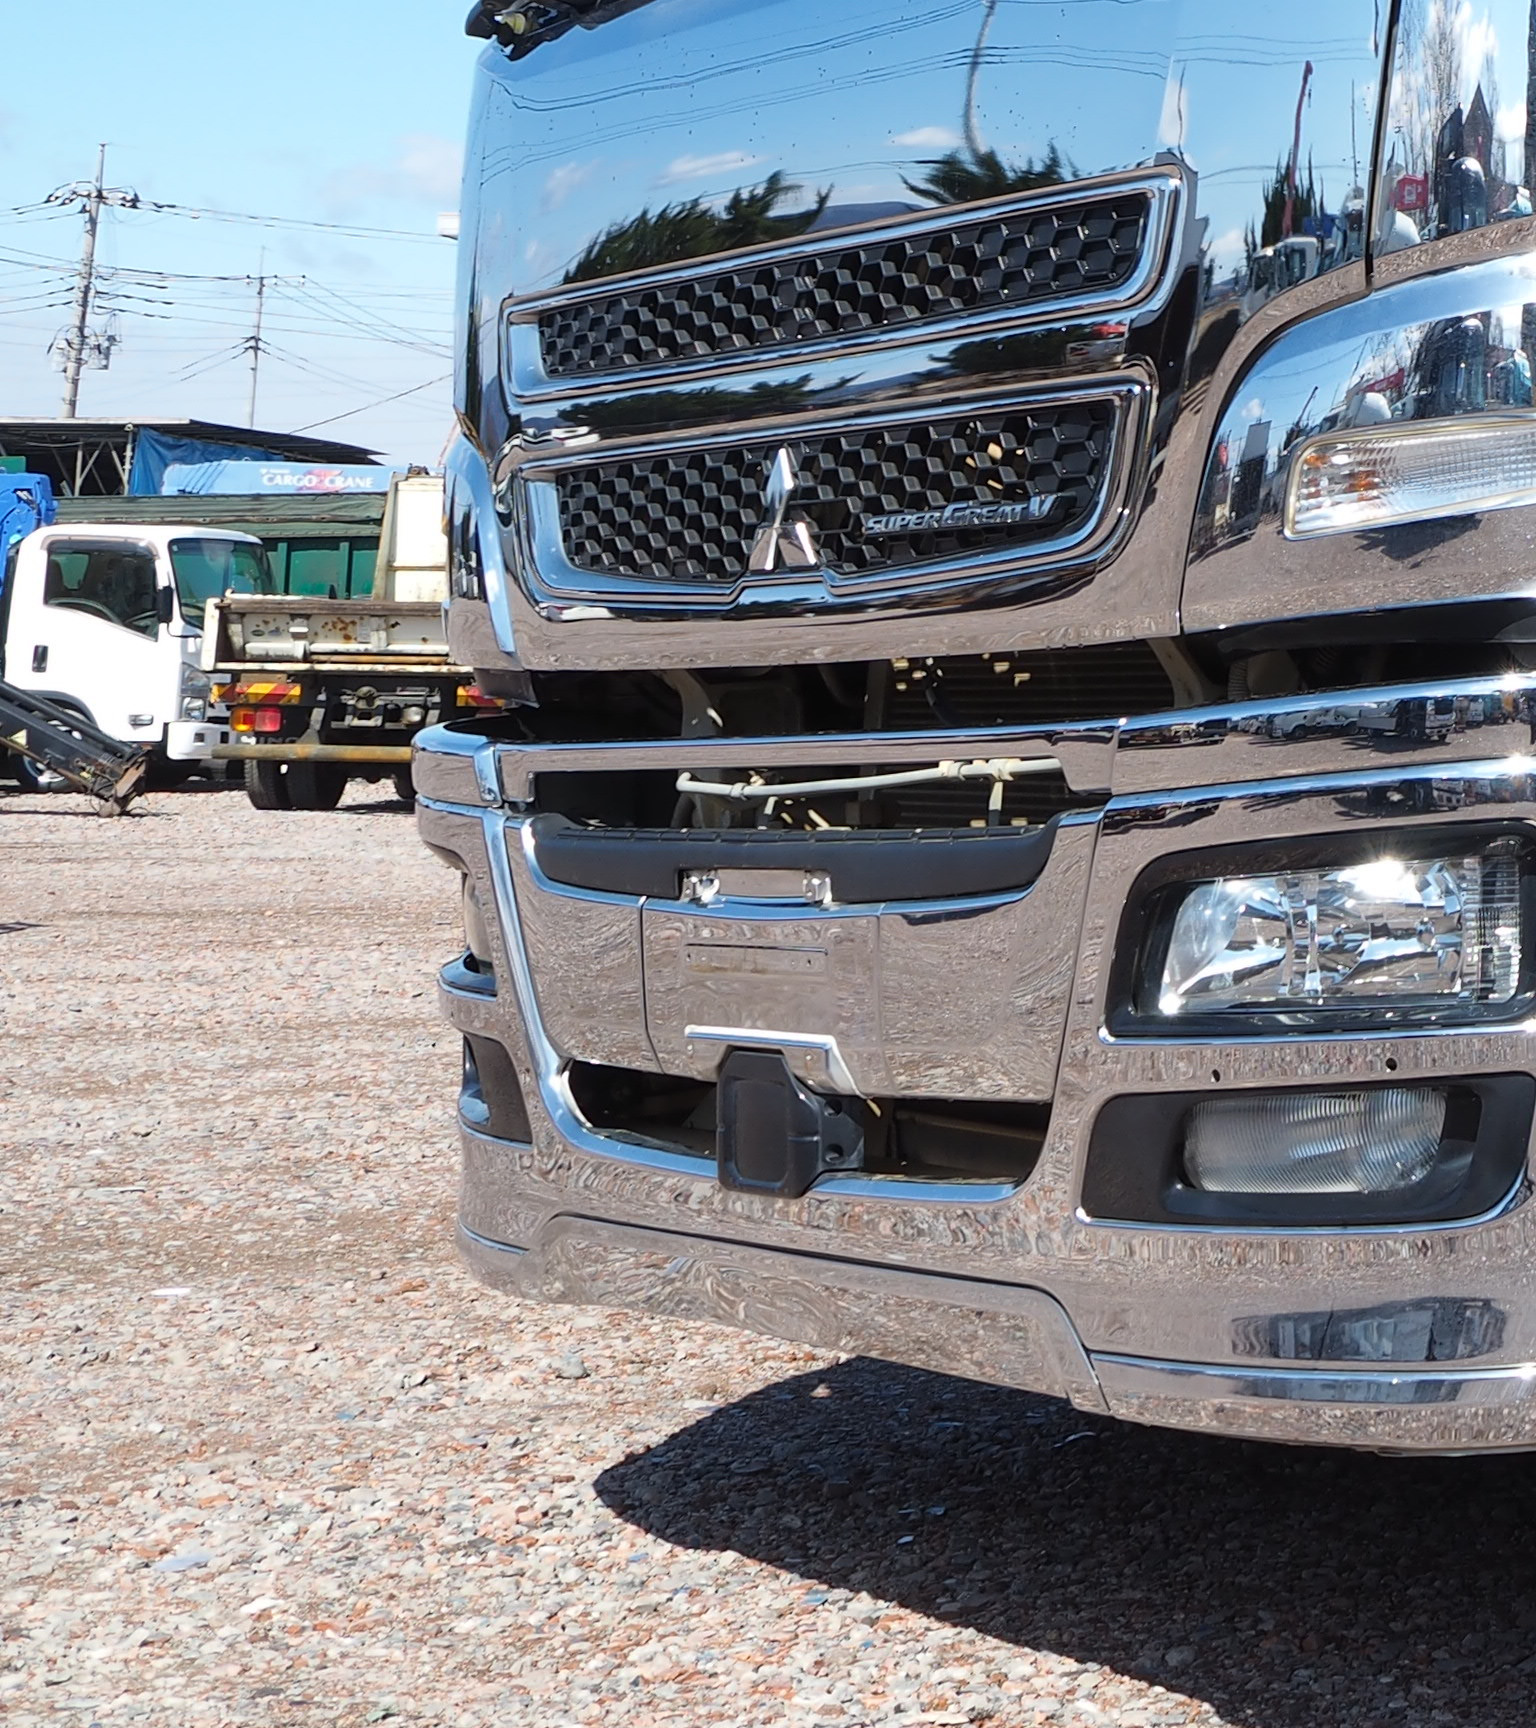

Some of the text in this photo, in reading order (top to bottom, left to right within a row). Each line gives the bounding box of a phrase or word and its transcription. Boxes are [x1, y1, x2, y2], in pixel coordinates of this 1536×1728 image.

[261, 474, 375, 488] CARGO CRANE
[865, 494, 1057, 534] SUPER GREAT V
